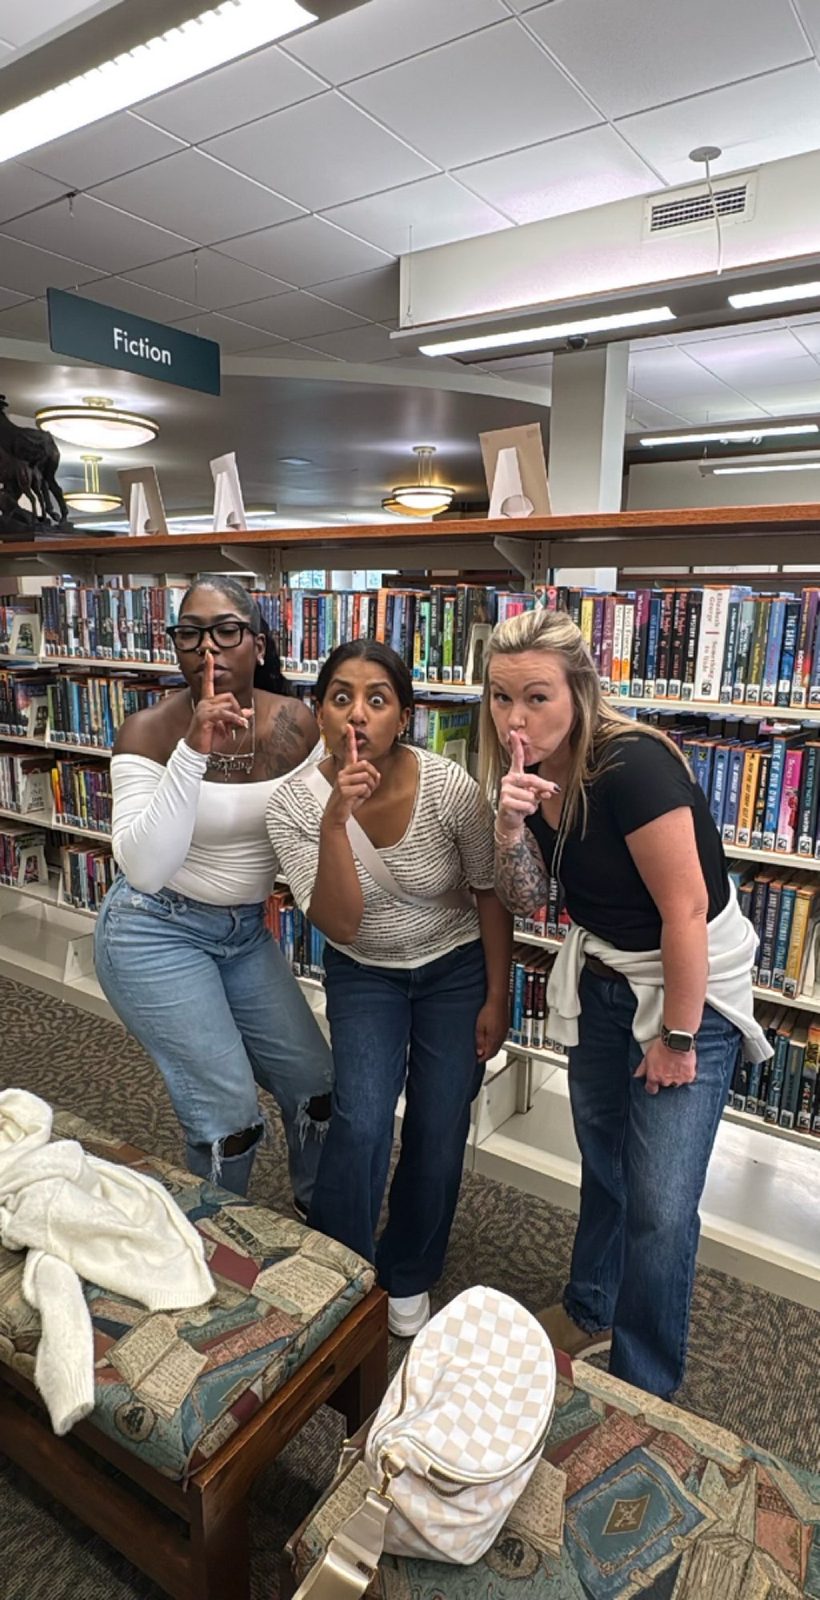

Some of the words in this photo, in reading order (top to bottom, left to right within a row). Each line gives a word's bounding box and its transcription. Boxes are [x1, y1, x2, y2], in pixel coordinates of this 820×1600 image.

[113, 327, 172, 366] Fiction
[707, 597, 715, 622] George
[714, 593, 723, 627] Elizabeth
[710, 641, 718, 679] Something
[772, 744, 782, 759] ONE
[772, 761, 780, 771] OF
[770, 773, 779, 787] OUR
[806, 767, 814, 788] WICKED
[768, 790, 777, 808] OWN
